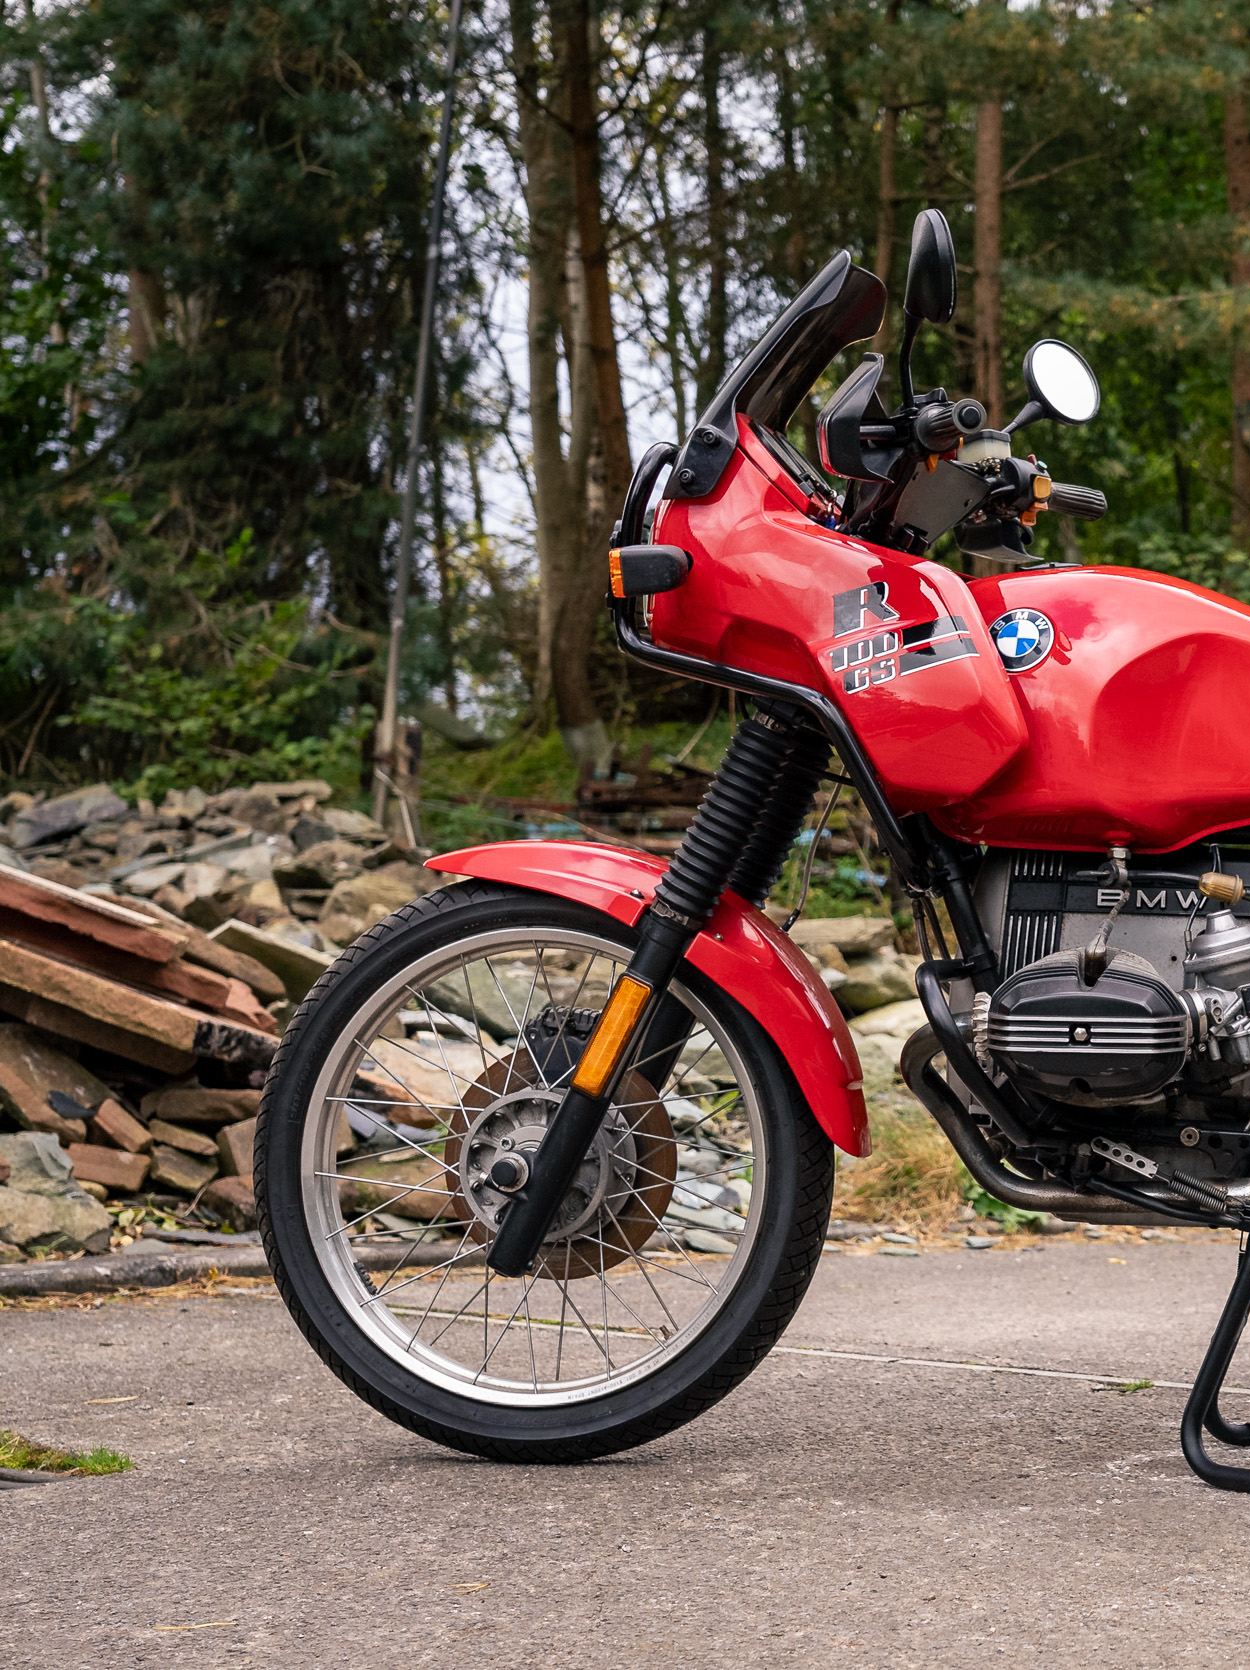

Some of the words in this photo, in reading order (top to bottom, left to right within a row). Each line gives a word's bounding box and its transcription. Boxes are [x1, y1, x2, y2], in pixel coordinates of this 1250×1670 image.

[833, 581, 900, 638] R
[994, 611, 1048, 631] BMW
[829, 631, 899, 672] 100
[843, 658, 896, 694] GS
[1096, 888, 1209, 909] BMW
